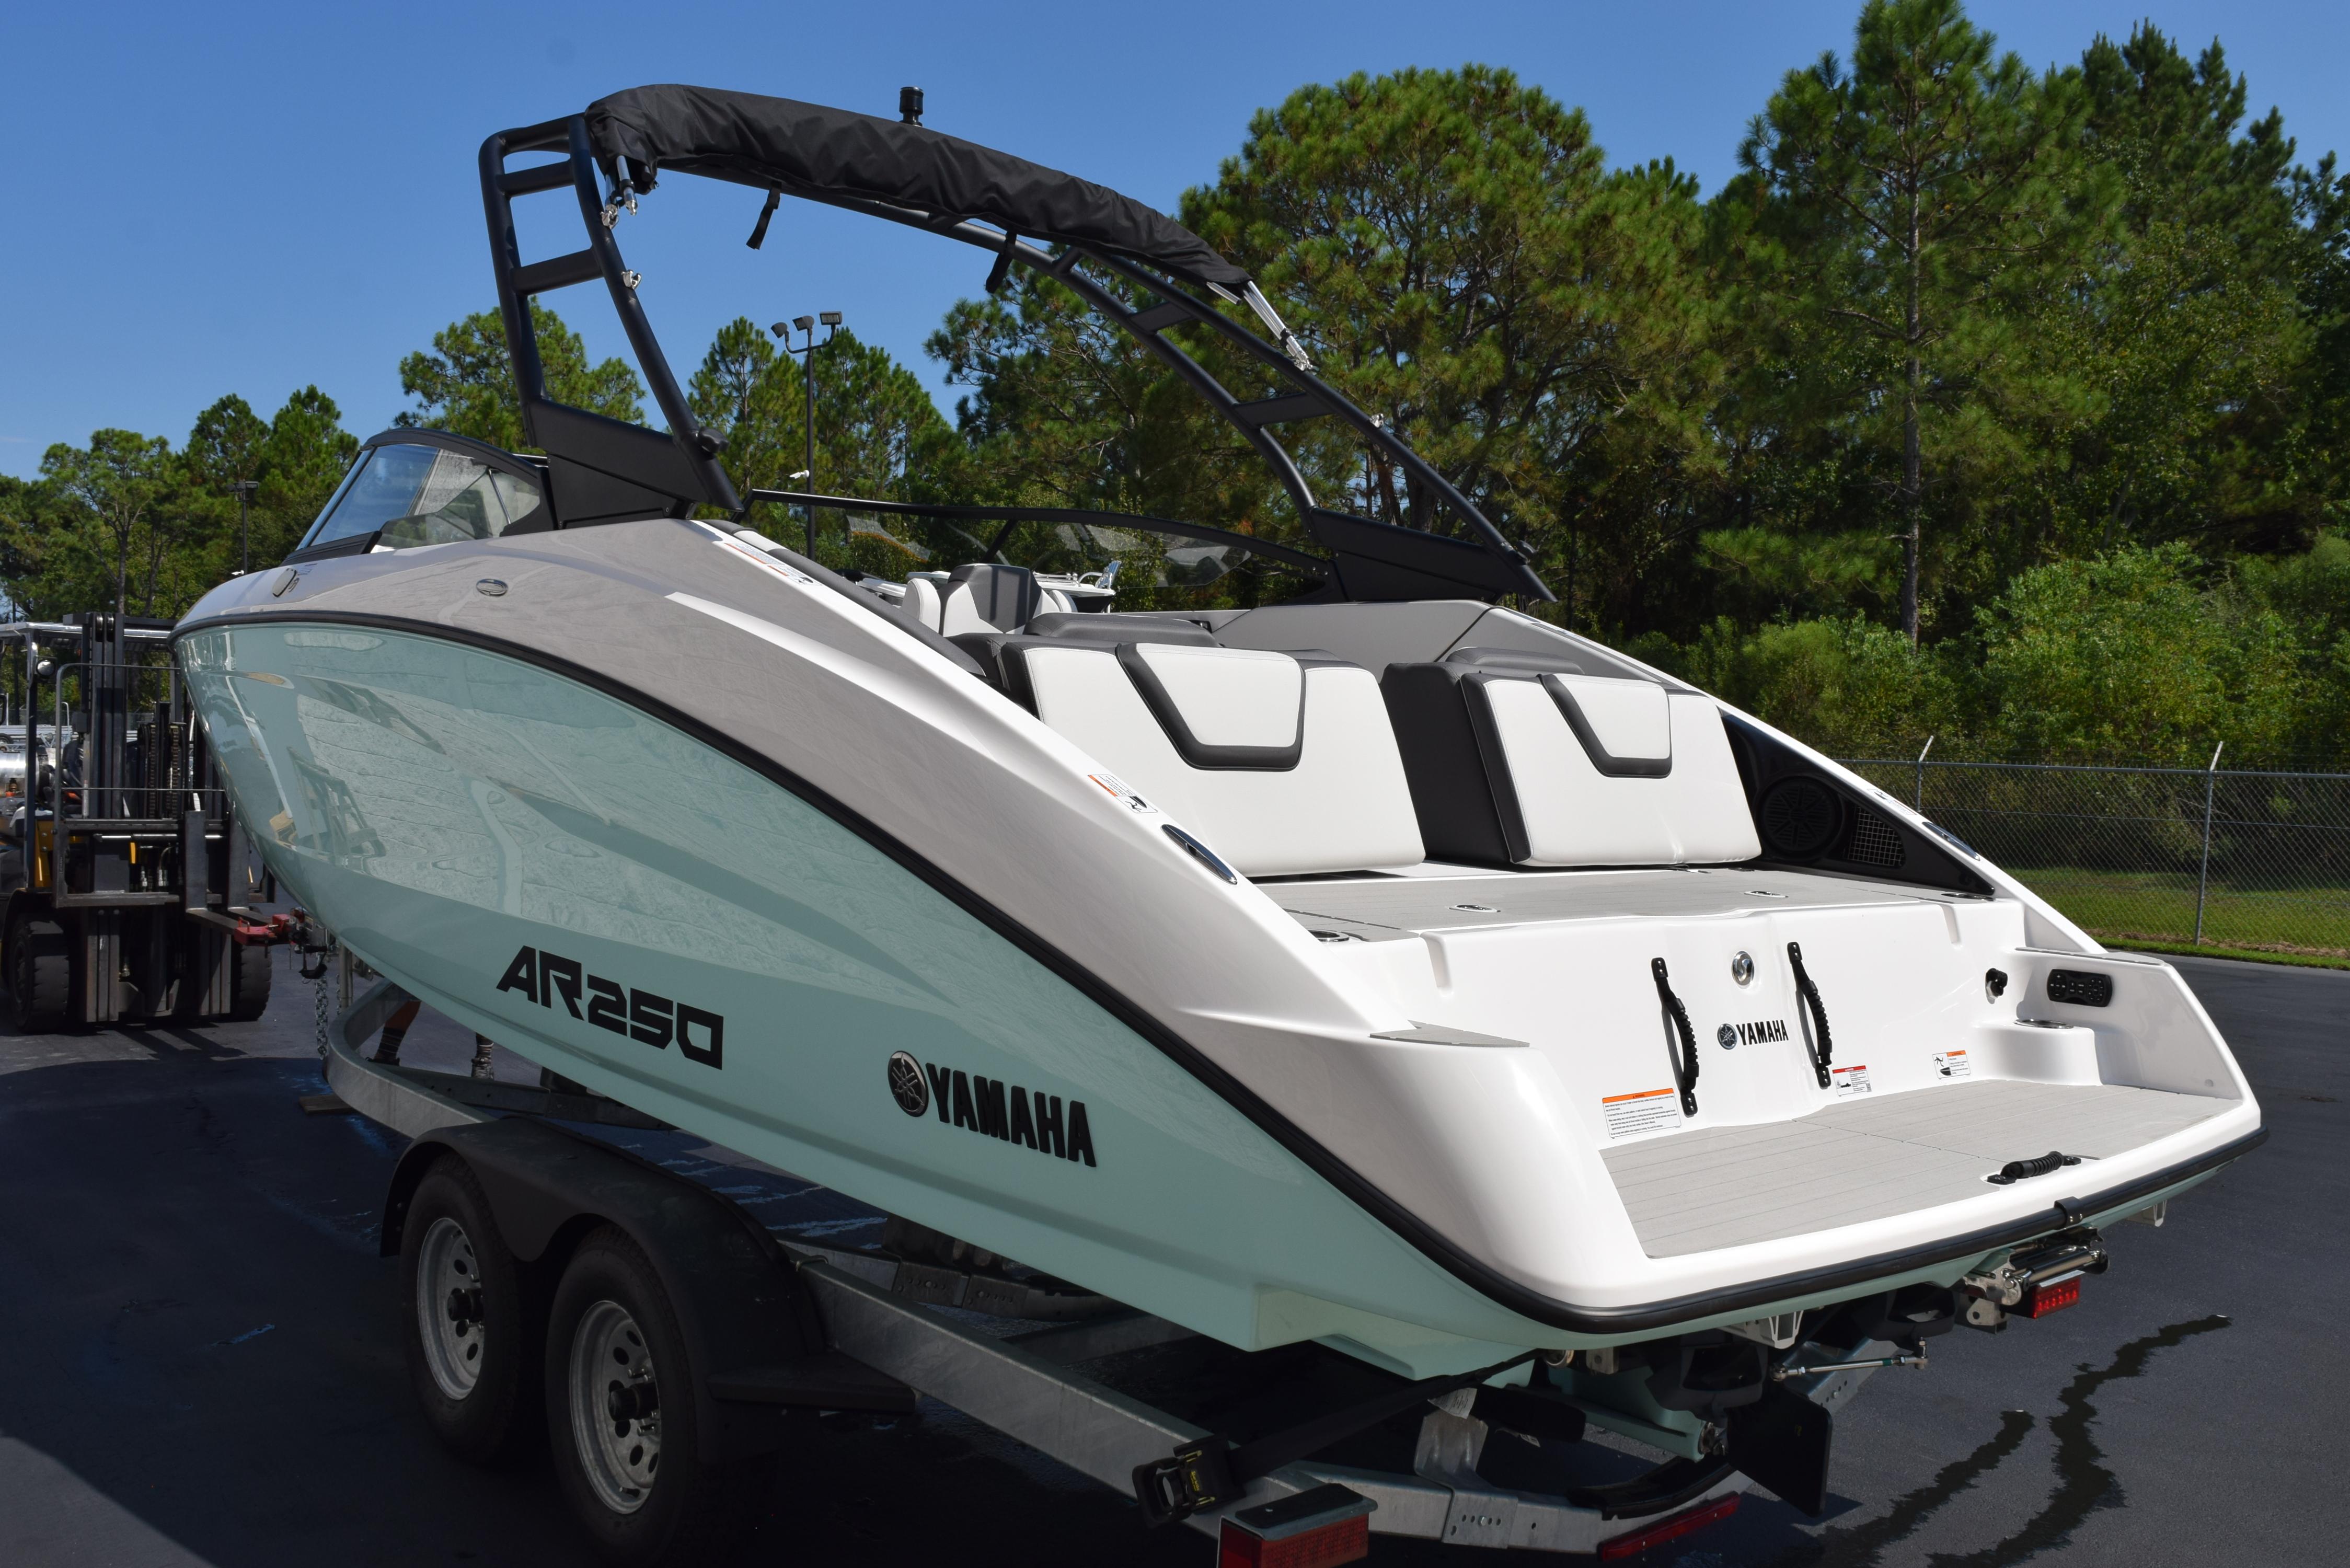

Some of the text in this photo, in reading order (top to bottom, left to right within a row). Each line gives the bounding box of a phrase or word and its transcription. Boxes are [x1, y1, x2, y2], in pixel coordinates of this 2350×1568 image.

[496, 945, 724, 1070] AR250
[1736, 1020, 1789, 1046] YAMAHA
[925, 1063, 1097, 1168] YAMAHA
